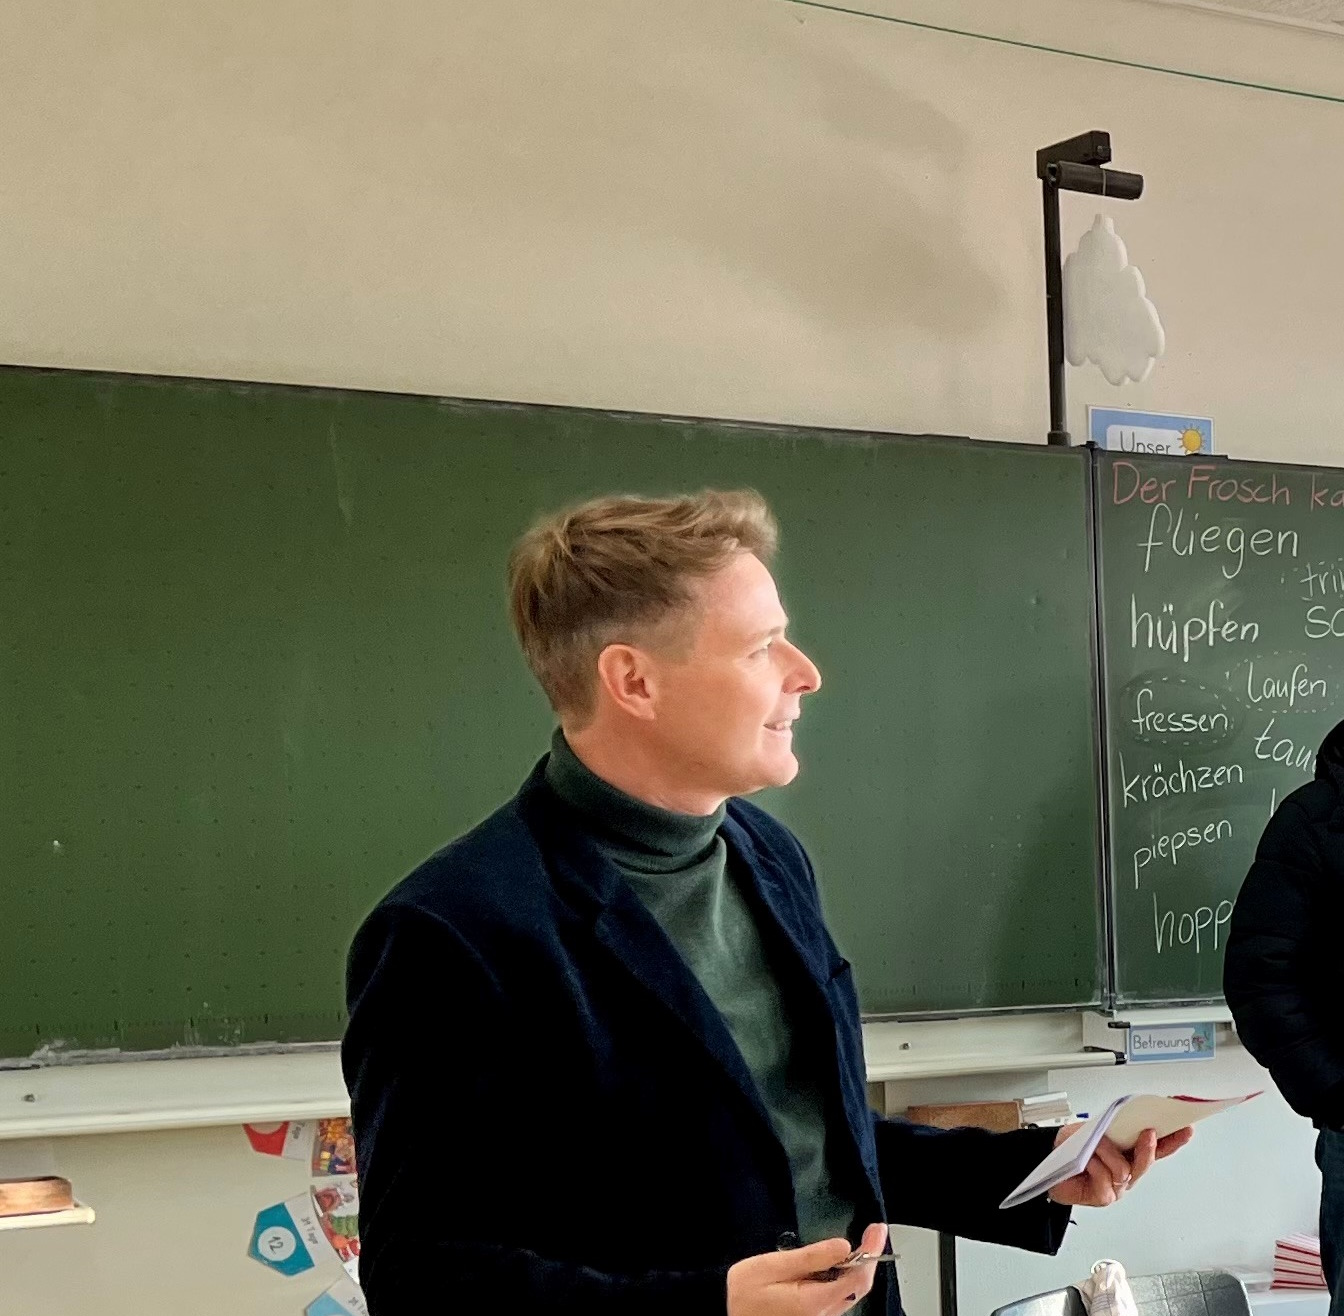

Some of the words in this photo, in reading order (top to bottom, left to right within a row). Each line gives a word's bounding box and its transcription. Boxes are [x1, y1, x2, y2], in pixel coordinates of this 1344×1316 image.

[1120, 430, 1171, 454] Unser
[1112, 461, 1177, 504] Der
[1187, 464, 1290, 506] Frosch
[1137, 503, 1299, 579] fliegen
[1130, 594, 1259, 663] hüpfen
[1132, 688, 1229, 735] fressen
[1254, 717, 1316, 774] tau
[1119, 751, 1244, 808] krächzen
[1133, 817, 1234, 889] piepsen
[1153, 892, 1235, 954] hopp
[1133, 1034, 1191, 1053] Betreuung
[267, 1235, 284, 1254] 12
